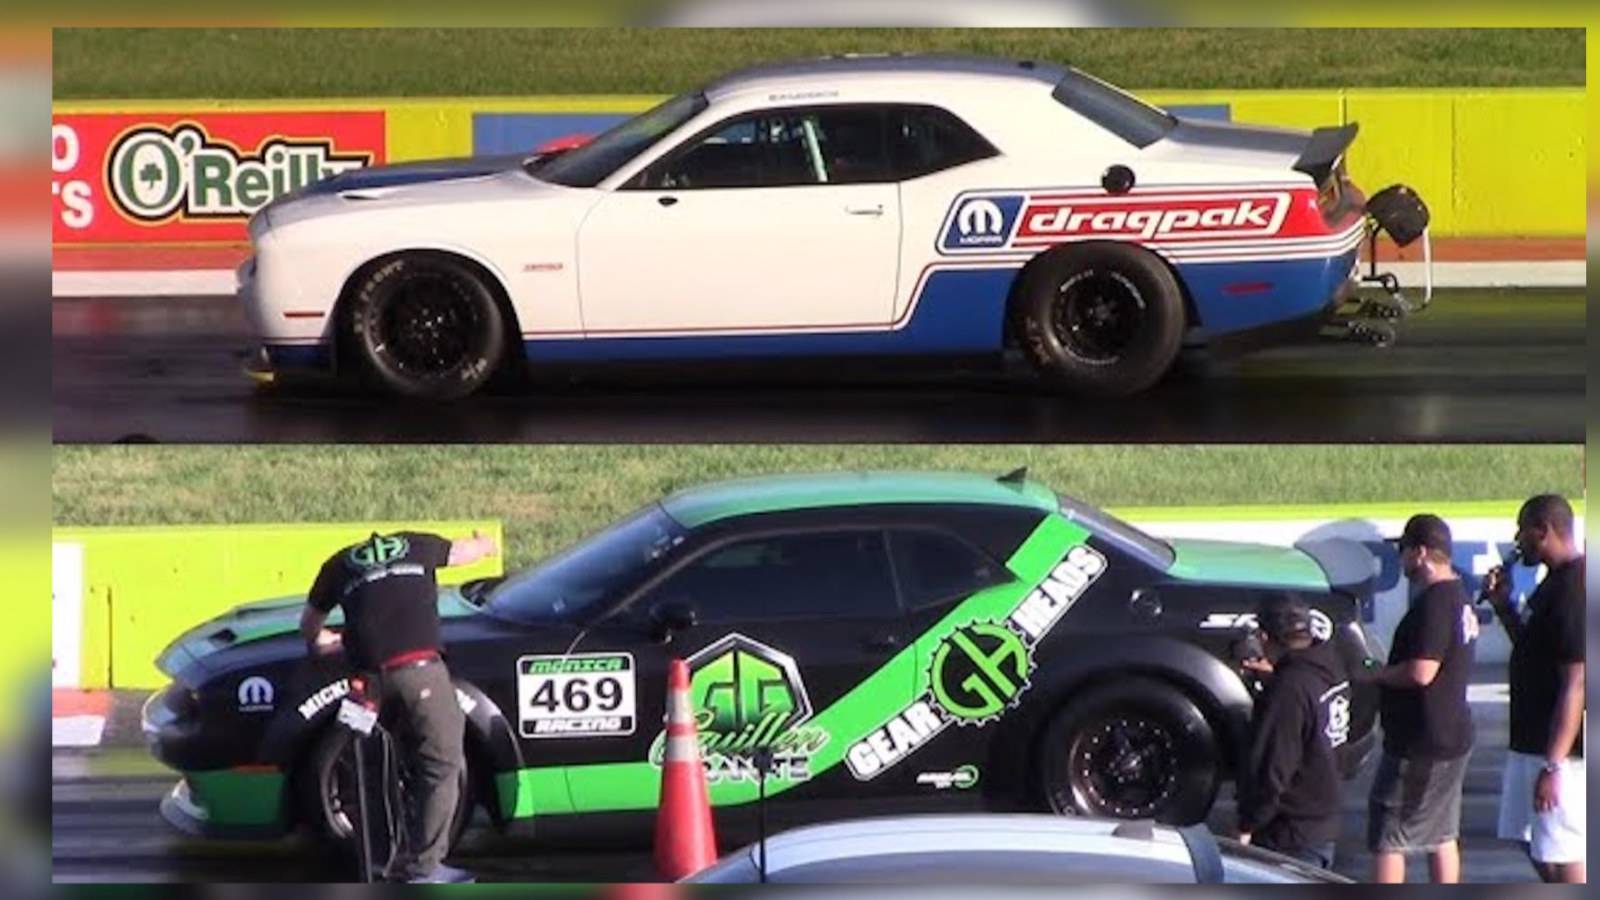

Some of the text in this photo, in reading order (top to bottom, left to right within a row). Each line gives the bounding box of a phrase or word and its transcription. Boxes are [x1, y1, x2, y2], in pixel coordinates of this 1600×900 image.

[114, 132, 356, 216] O'Reill
[1028, 197, 1279, 238] dragpak
[1010, 546, 1102, 638] HEADS
[530, 677, 624, 713] 469
[534, 716, 622, 733] RACING
[849, 701, 943, 776] GEAR
